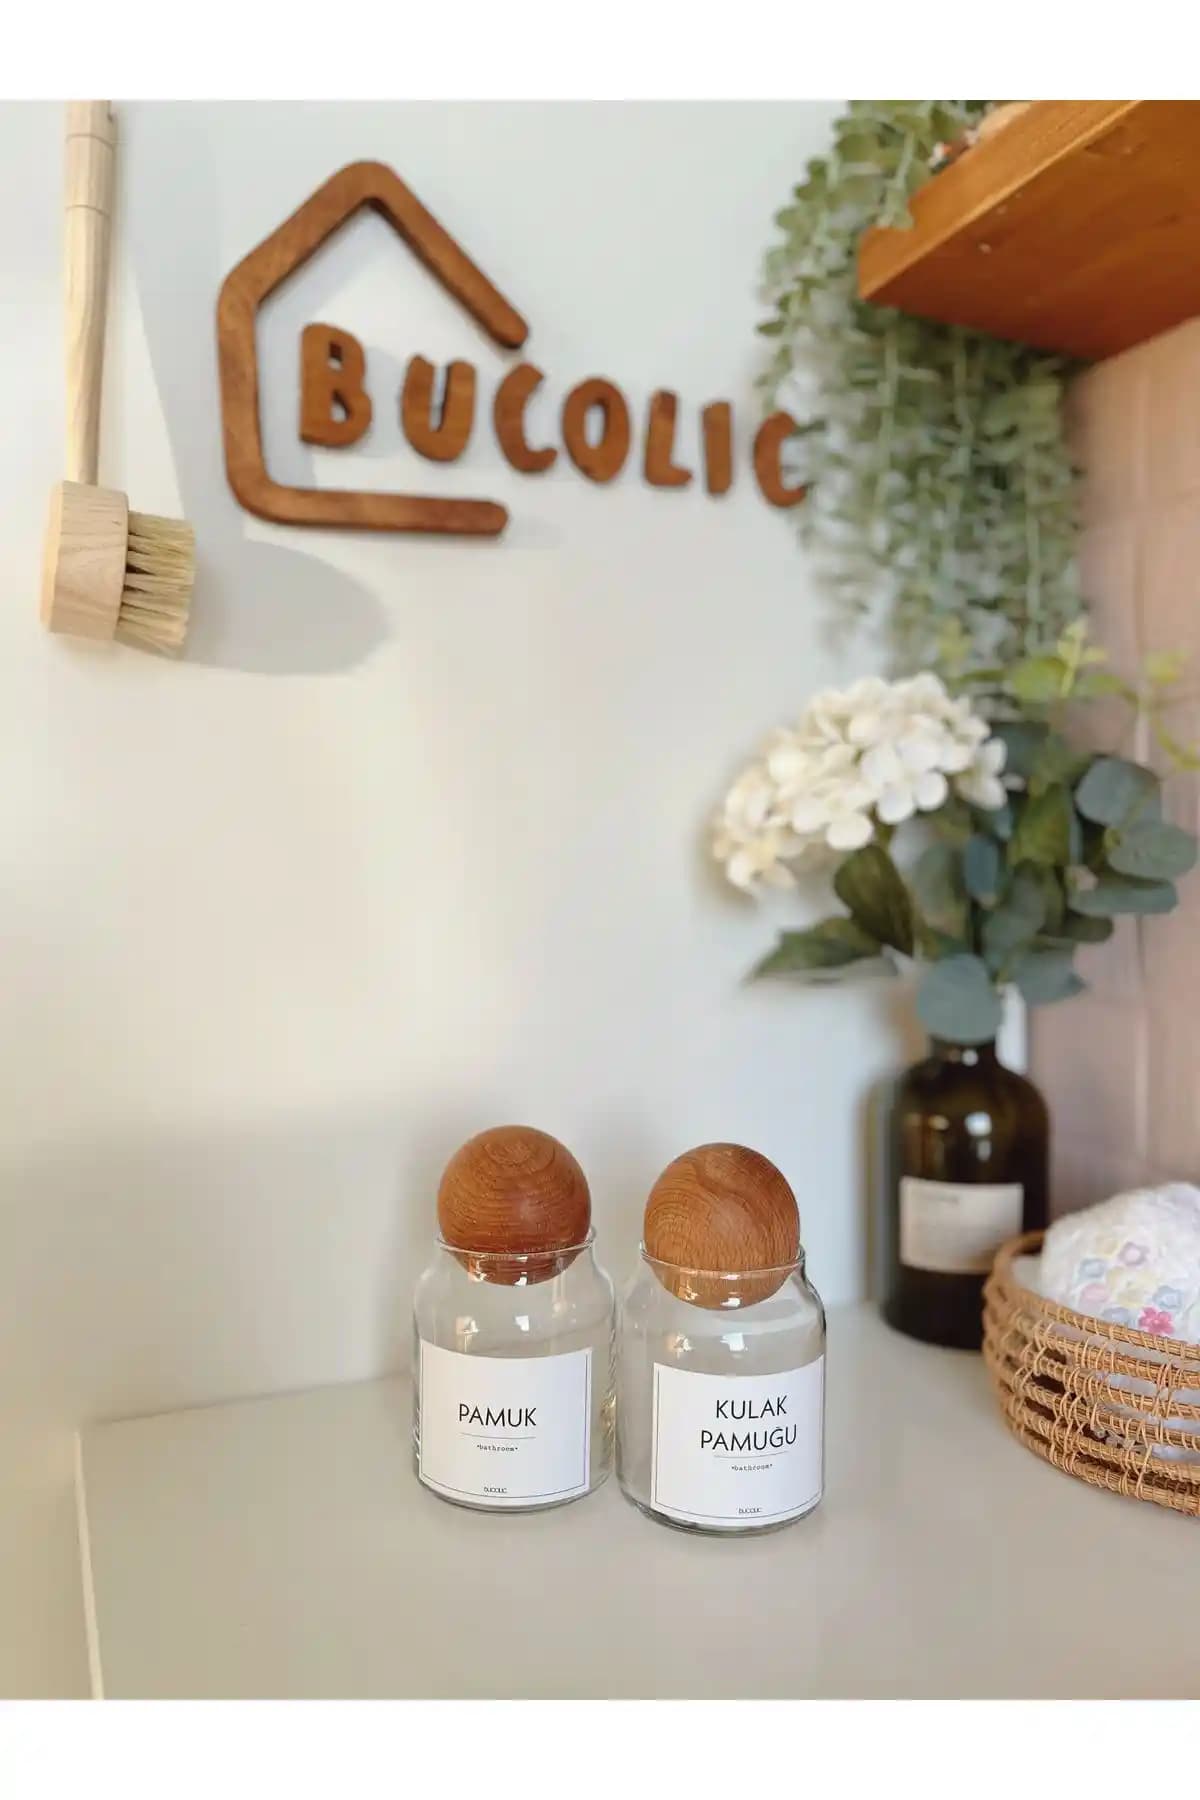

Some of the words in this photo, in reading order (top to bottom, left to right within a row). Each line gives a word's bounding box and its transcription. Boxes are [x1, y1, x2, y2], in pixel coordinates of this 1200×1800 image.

[300, 322, 807, 509] BUCOLIC
[458, 1403, 537, 1428] PAMUK
[715, 1395, 788, 1420] KULAK
[700, 1424, 797, 1451] PAMUĞU
